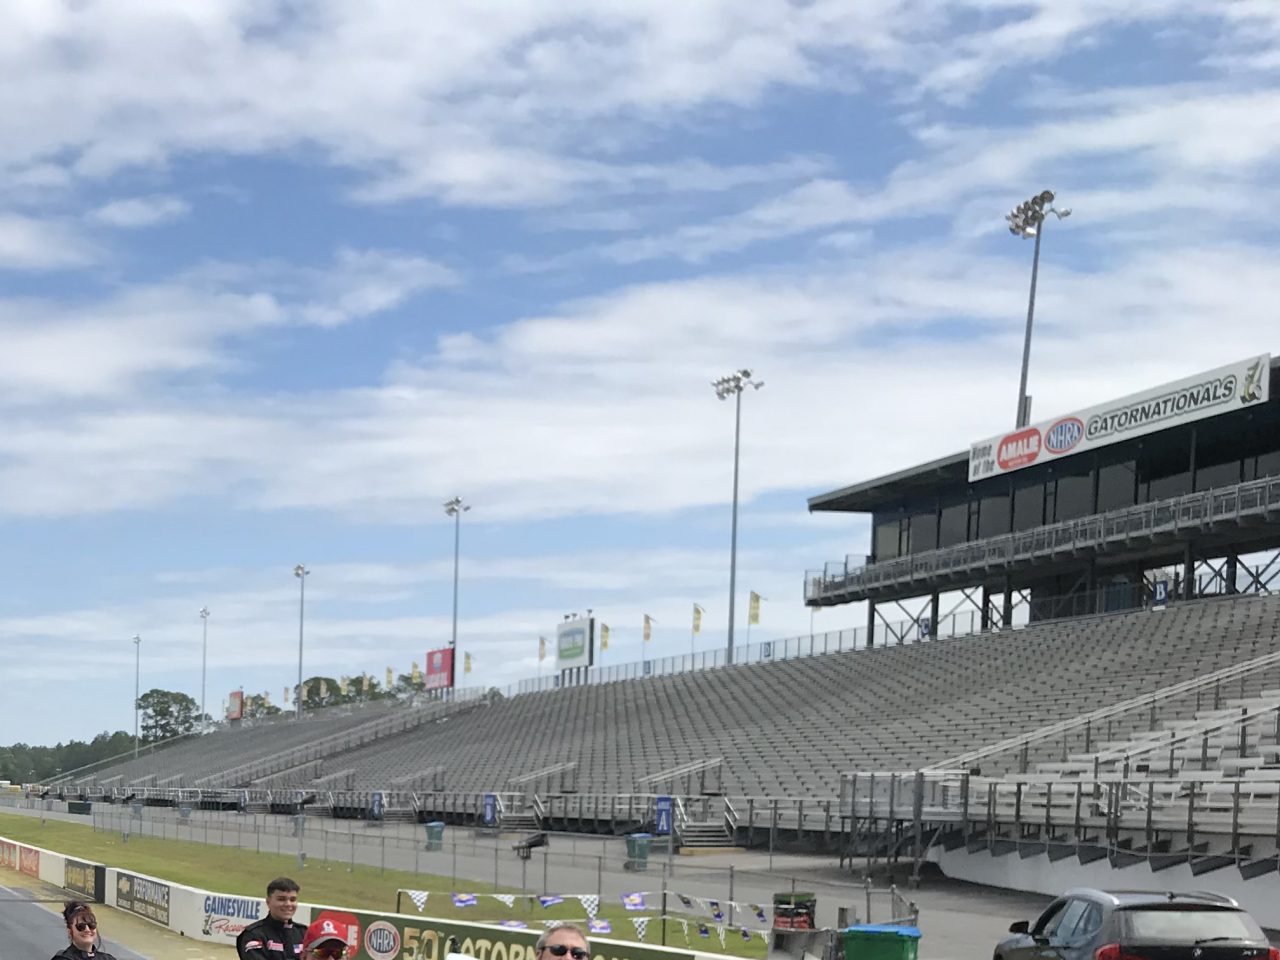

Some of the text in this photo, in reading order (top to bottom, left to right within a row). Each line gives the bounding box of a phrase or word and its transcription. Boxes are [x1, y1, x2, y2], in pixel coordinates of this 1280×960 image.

[1087, 378, 1235, 437] GATORNATIONALS
[1048, 422, 1080, 449] NHRA
[204, 896, 261, 919] GAINESVILLE
[370, 929, 394, 949] NHRA
